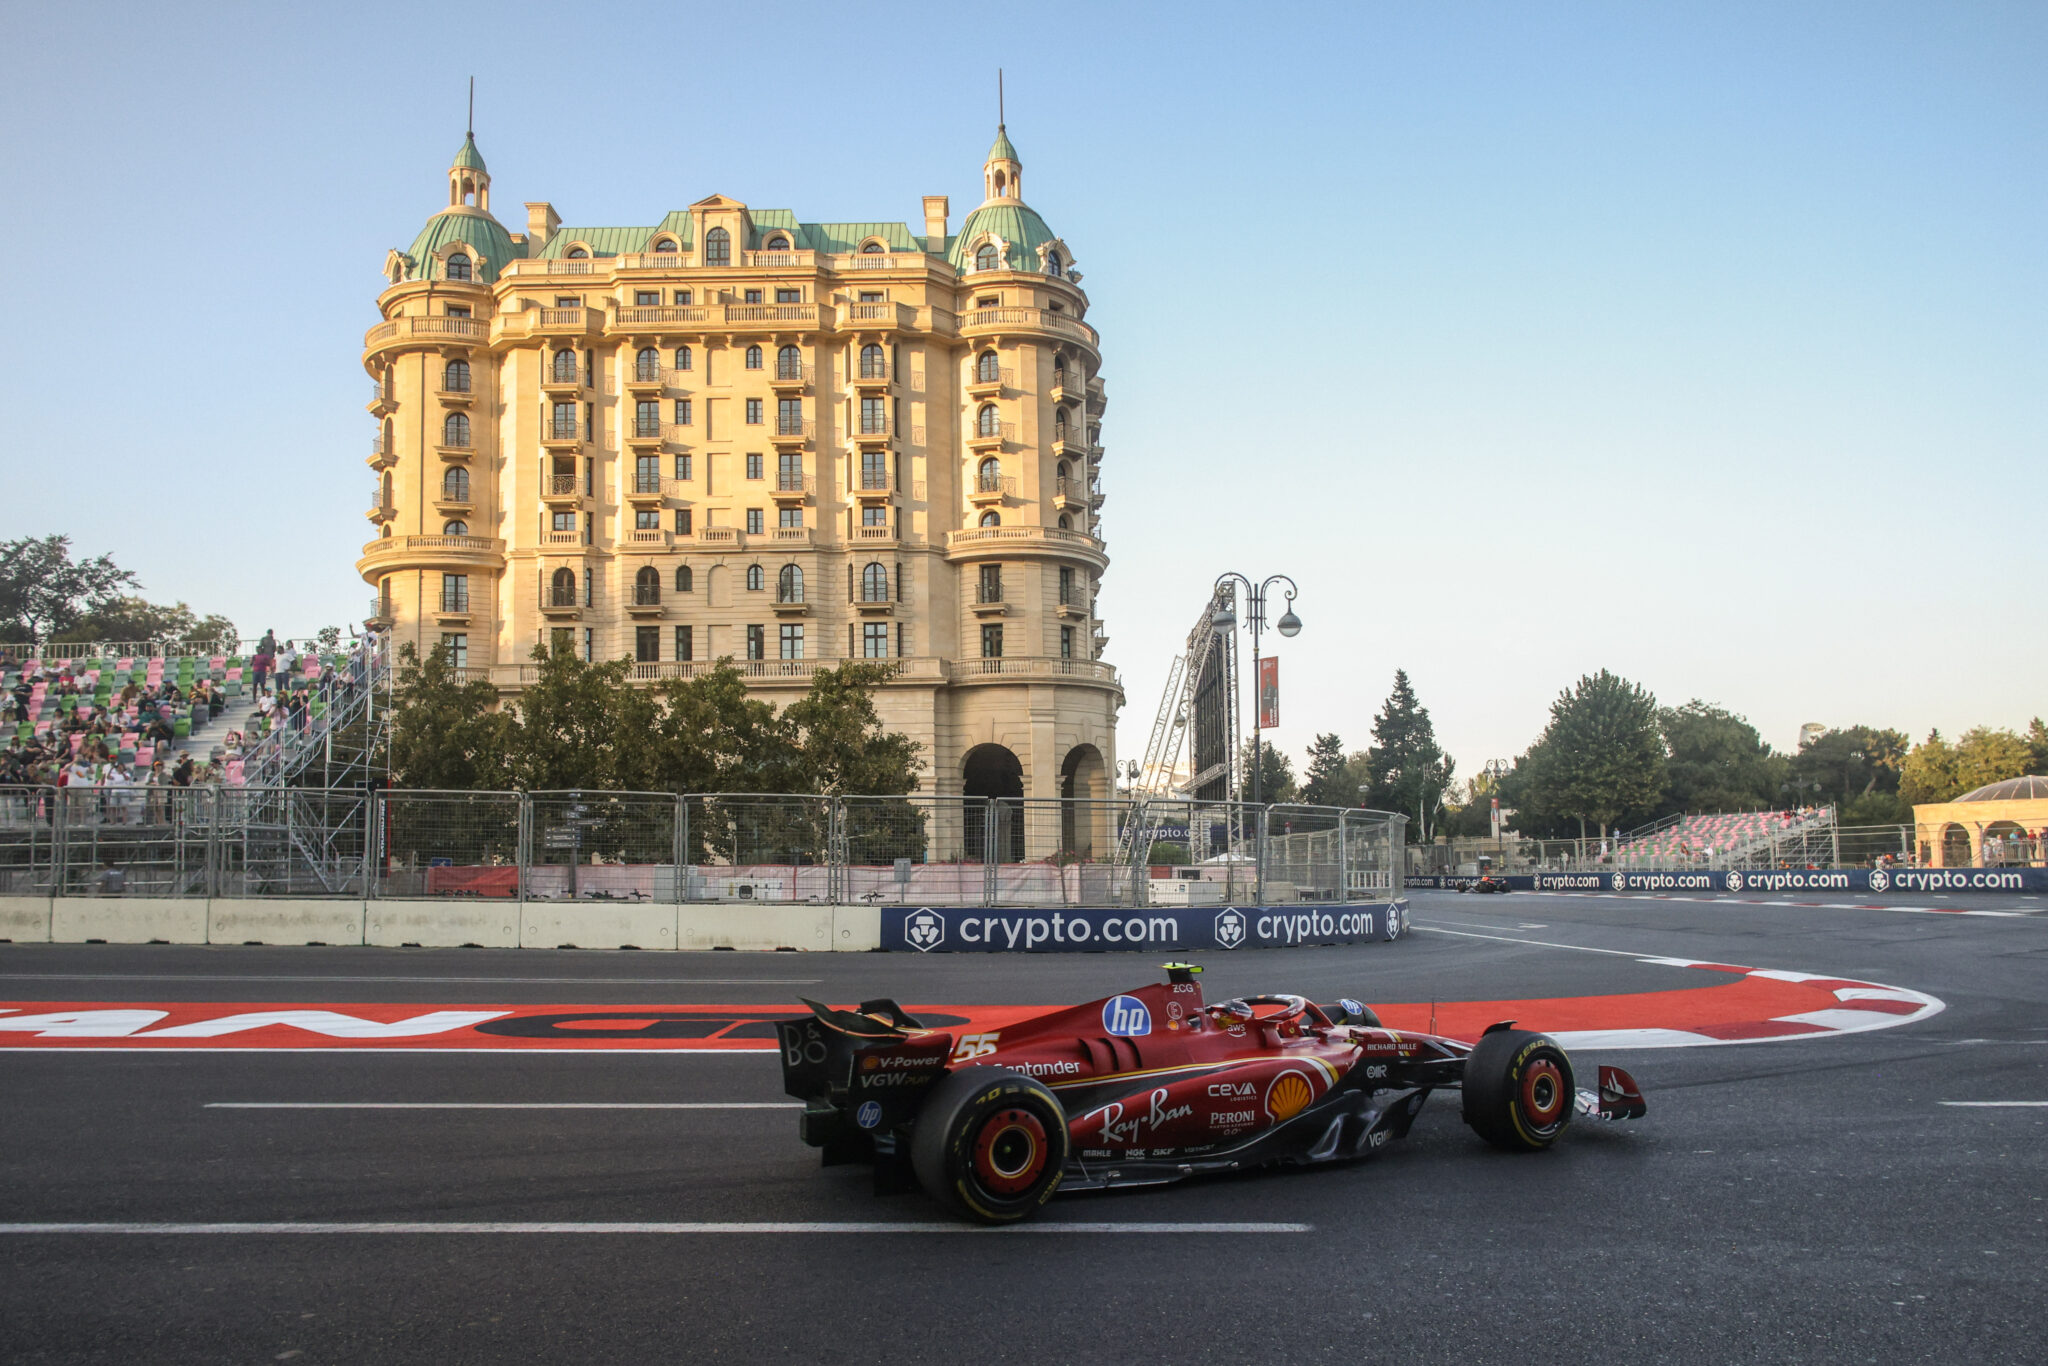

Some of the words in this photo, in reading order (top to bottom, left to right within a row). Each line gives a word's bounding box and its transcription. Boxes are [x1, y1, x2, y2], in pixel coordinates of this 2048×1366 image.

[1542, 873, 1600, 890] crypto.com
[1629, 873, 1711, 890] crypto.com
[1748, 871, 1849, 891] crypto.com
[1895, 870, 2024, 891] crypto.com
[959, 912, 1178, 949] crypto.com
[1257, 909, 1373, 944] crypto.com
[1172, 983, 1194, 993] ZCG
[0, 1008, 514, 1039] AN
[1111, 996, 1145, 1036] hp
[1227, 1024, 1246, 1032] aws
[952, 1032, 1001, 1063] 55
[1367, 1043, 1396, 1051] RICHARD
[879, 1056, 941, 1068] V-Power
[861, 1072, 907, 1088] VGW
[861, 1102, 878, 1128] hp
[1210, 1109, 1255, 1125] PERONI
